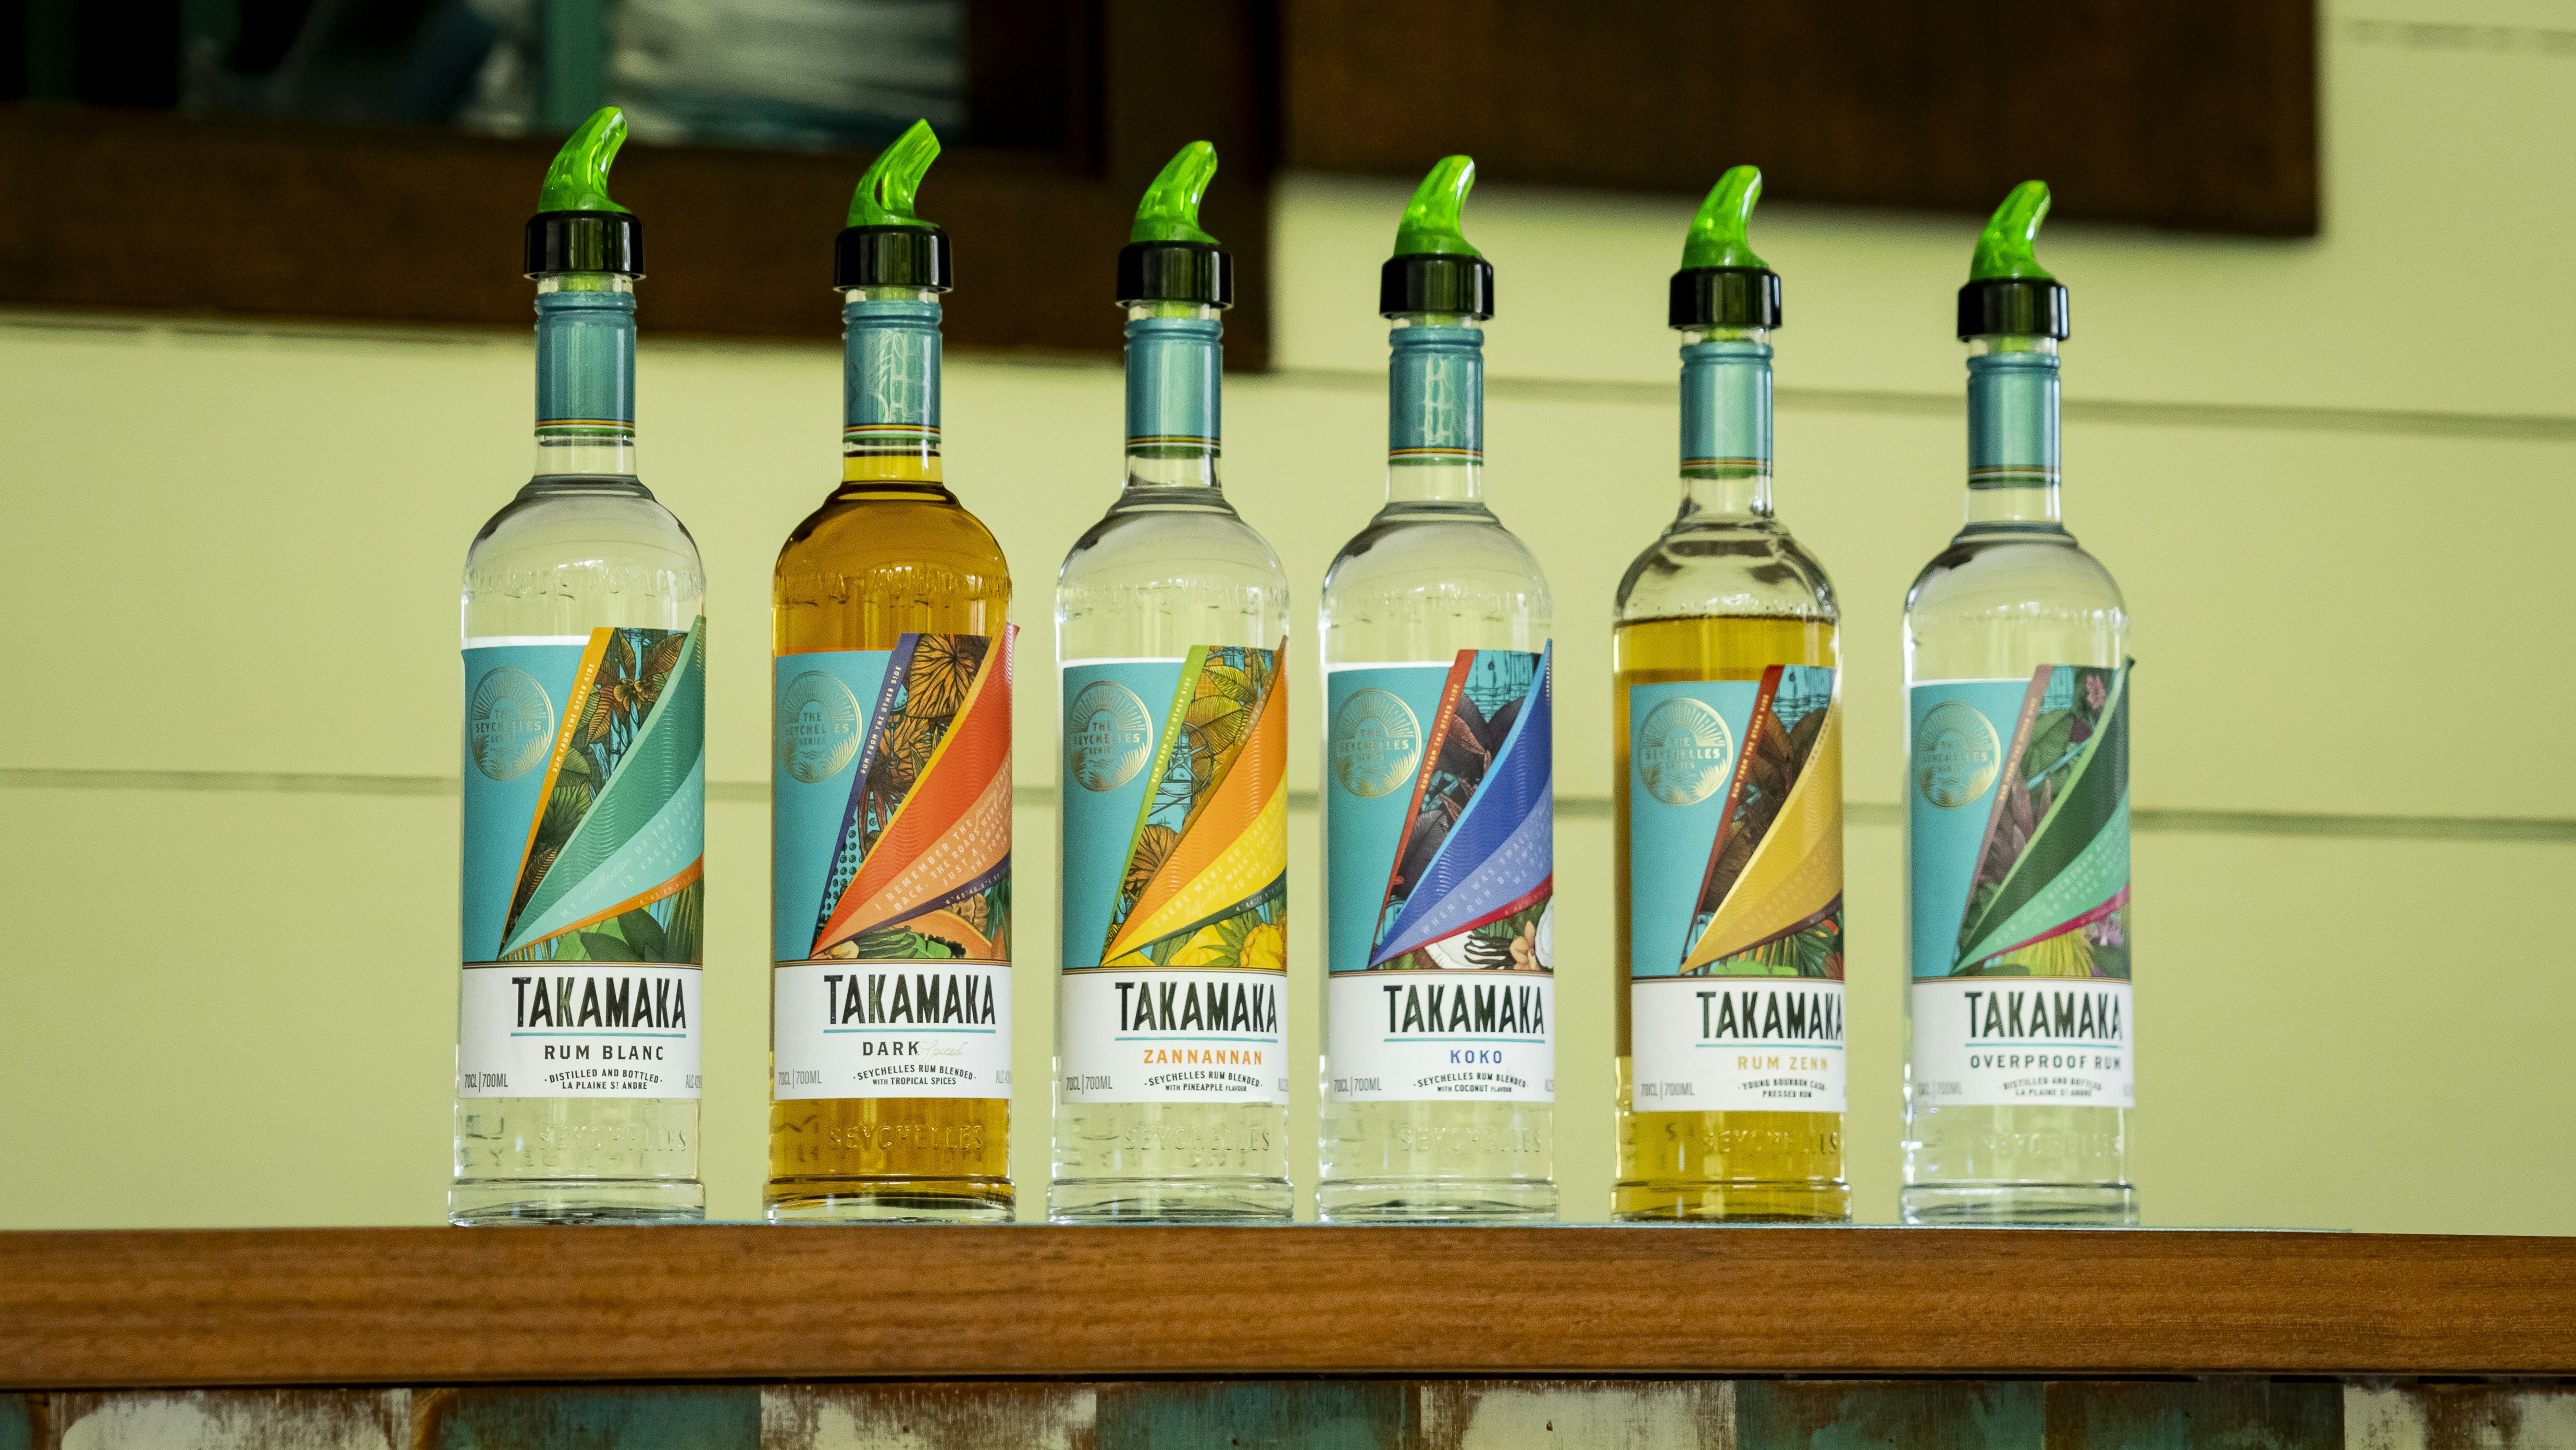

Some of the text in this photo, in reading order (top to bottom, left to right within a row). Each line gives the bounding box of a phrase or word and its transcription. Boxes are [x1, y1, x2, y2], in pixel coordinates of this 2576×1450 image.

[552, 663, 595, 772] RUM FROM THE OTHER SIDE
[803, 711, 822, 722] THE
[861, 666, 902, 774] RUM FROM THE OTHER SIDE
[1093, 721, 1111, 731] THE
[1073, 733, 1141, 745] SEYCHELLES
[635, 839, 649, 854] OF
[930, 859, 951, 879] THE
[952, 828, 980, 859] ROADS
[886, 843, 950, 901] REMEMBER
[953, 819, 973, 840] THE
[943, 859, 968, 887] JUST
[971, 848, 978, 856] A
[971, 854, 987, 874] THE
[1153, 895, 1190, 927] THERE
[1194, 865, 1224, 893] WERE
[1228, 849, 1241, 863] NO
[1420, 904, 1455, 935] WHEN
[1472, 868, 1495, 891] WAS
[512, 977, 686, 1028] TAKAMAKA
[824, 974, 996, 1025] TAKAMAKA
[1115, 982, 1278, 1033] TAKAMAKA
[1383, 985, 1544, 1034] TAKAMAKA
[1696, 991, 1843, 1040] TAKAMAKA
[1965, 991, 2123, 1040] TAKAMAKA
[544, 1046, 663, 1060] RUM BLANC
[863, 1042, 920, 1055] DARK
[1144, 1049, 1262, 1064] ZANNANNAN
[1450, 1050, 1502, 1064] KOKO
[1738, 1056, 1828, 1070] RUM ZENN
[1970, 1054, 2121, 1070] OVERPROOF RUM
[550, 1068, 659, 1083] DISTILLED AND BOTTLED
[858, 1065, 973, 1080] SEYCHELLES RUM BLENDED
[1149, 1071, 1205, 1086] SEYCHELLES
[1229, 1073, 1260, 1087] BLENDED
[1418, 1073, 1473, 1087] SEYCHELLES
